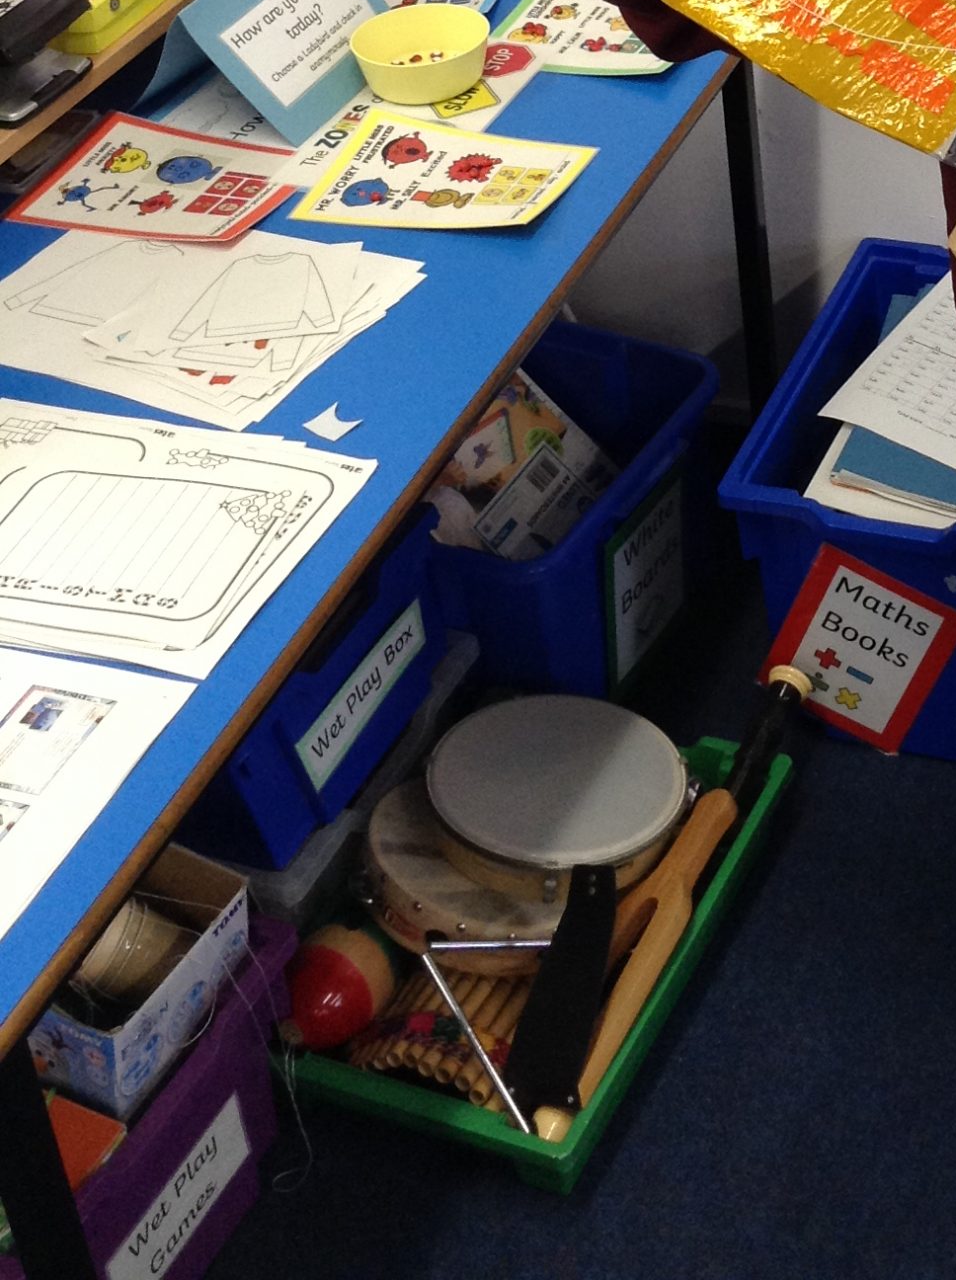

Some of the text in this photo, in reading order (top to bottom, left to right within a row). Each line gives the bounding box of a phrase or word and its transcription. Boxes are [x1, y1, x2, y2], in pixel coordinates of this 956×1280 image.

[230, 22, 264, 48] How
[263, 6, 284, 25] are
[285, 4, 324, 39] today?
[484, 48, 514, 71] STOP
[300, 149, 329, 166] The
[354, 140, 373, 161] LITTLE
[363, 125, 394, 163] FRUSTRATED
[421, 151, 447, 178] Excited
[315, 166, 360, 212] MR. WORRY
[403, 181, 421, 202] SILLY
[835, 577, 929, 636] Maths
[821, 611, 909, 667] Books
[311, 626, 413, 758] Wet Play Box
[212, 897, 246, 937] TOMY
[128, 1134, 218, 1257] Wet Play
[150, 1179, 217, 1274] Games
